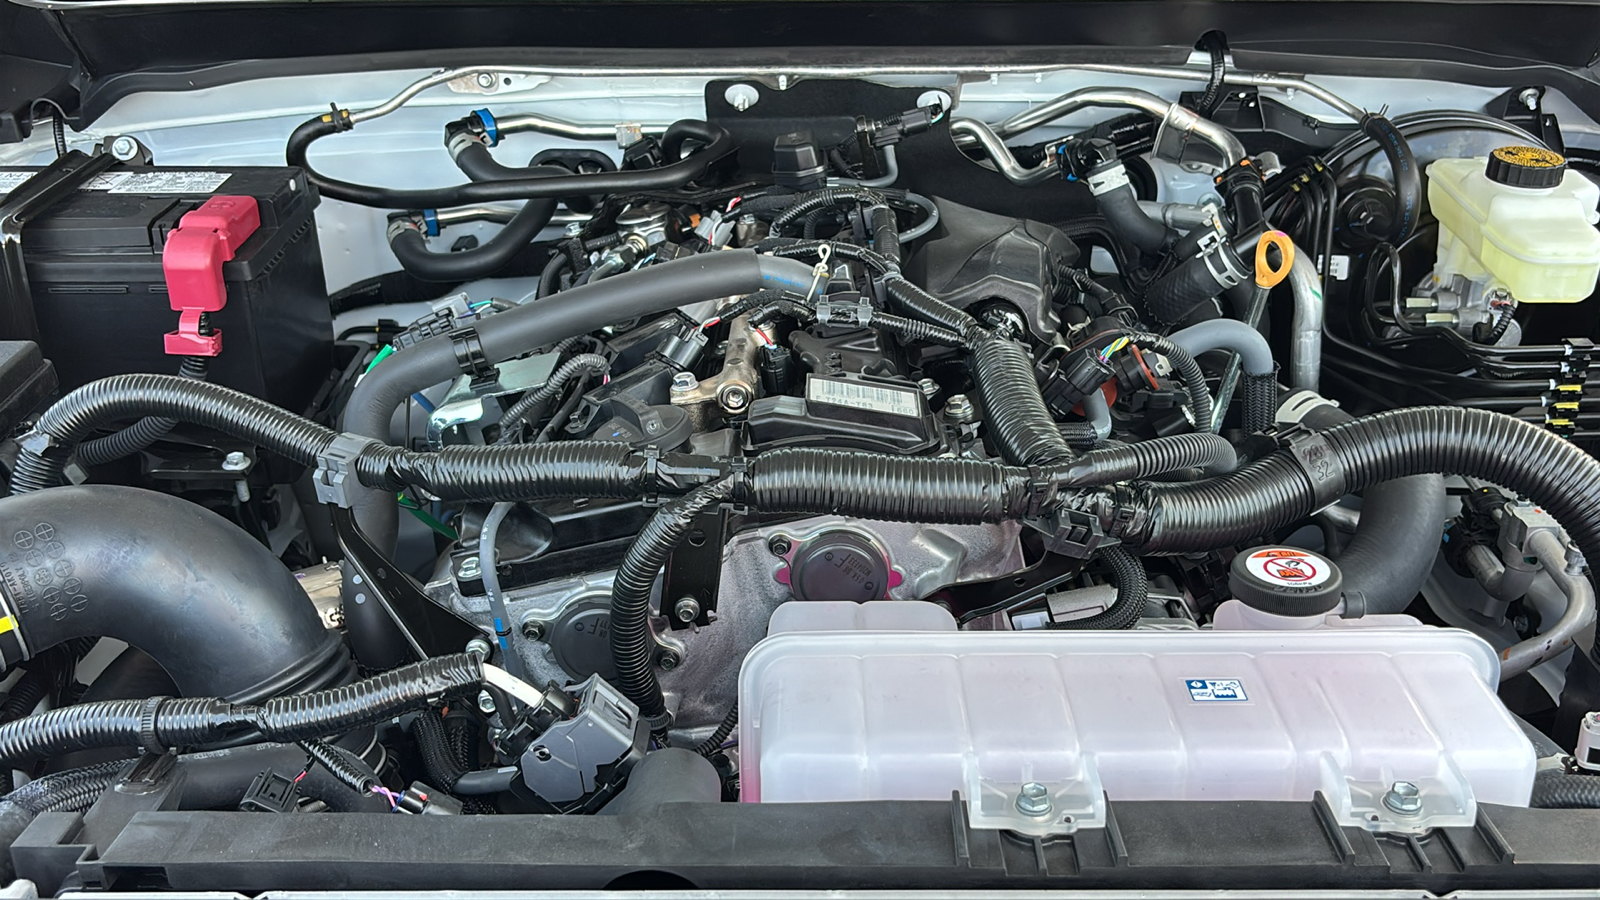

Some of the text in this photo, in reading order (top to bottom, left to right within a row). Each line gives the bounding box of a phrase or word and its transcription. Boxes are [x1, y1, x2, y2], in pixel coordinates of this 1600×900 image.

[1312, 460, 1335, 482] 32
[834, 554, 851, 568] F
[588, 617, 600, 635] F
